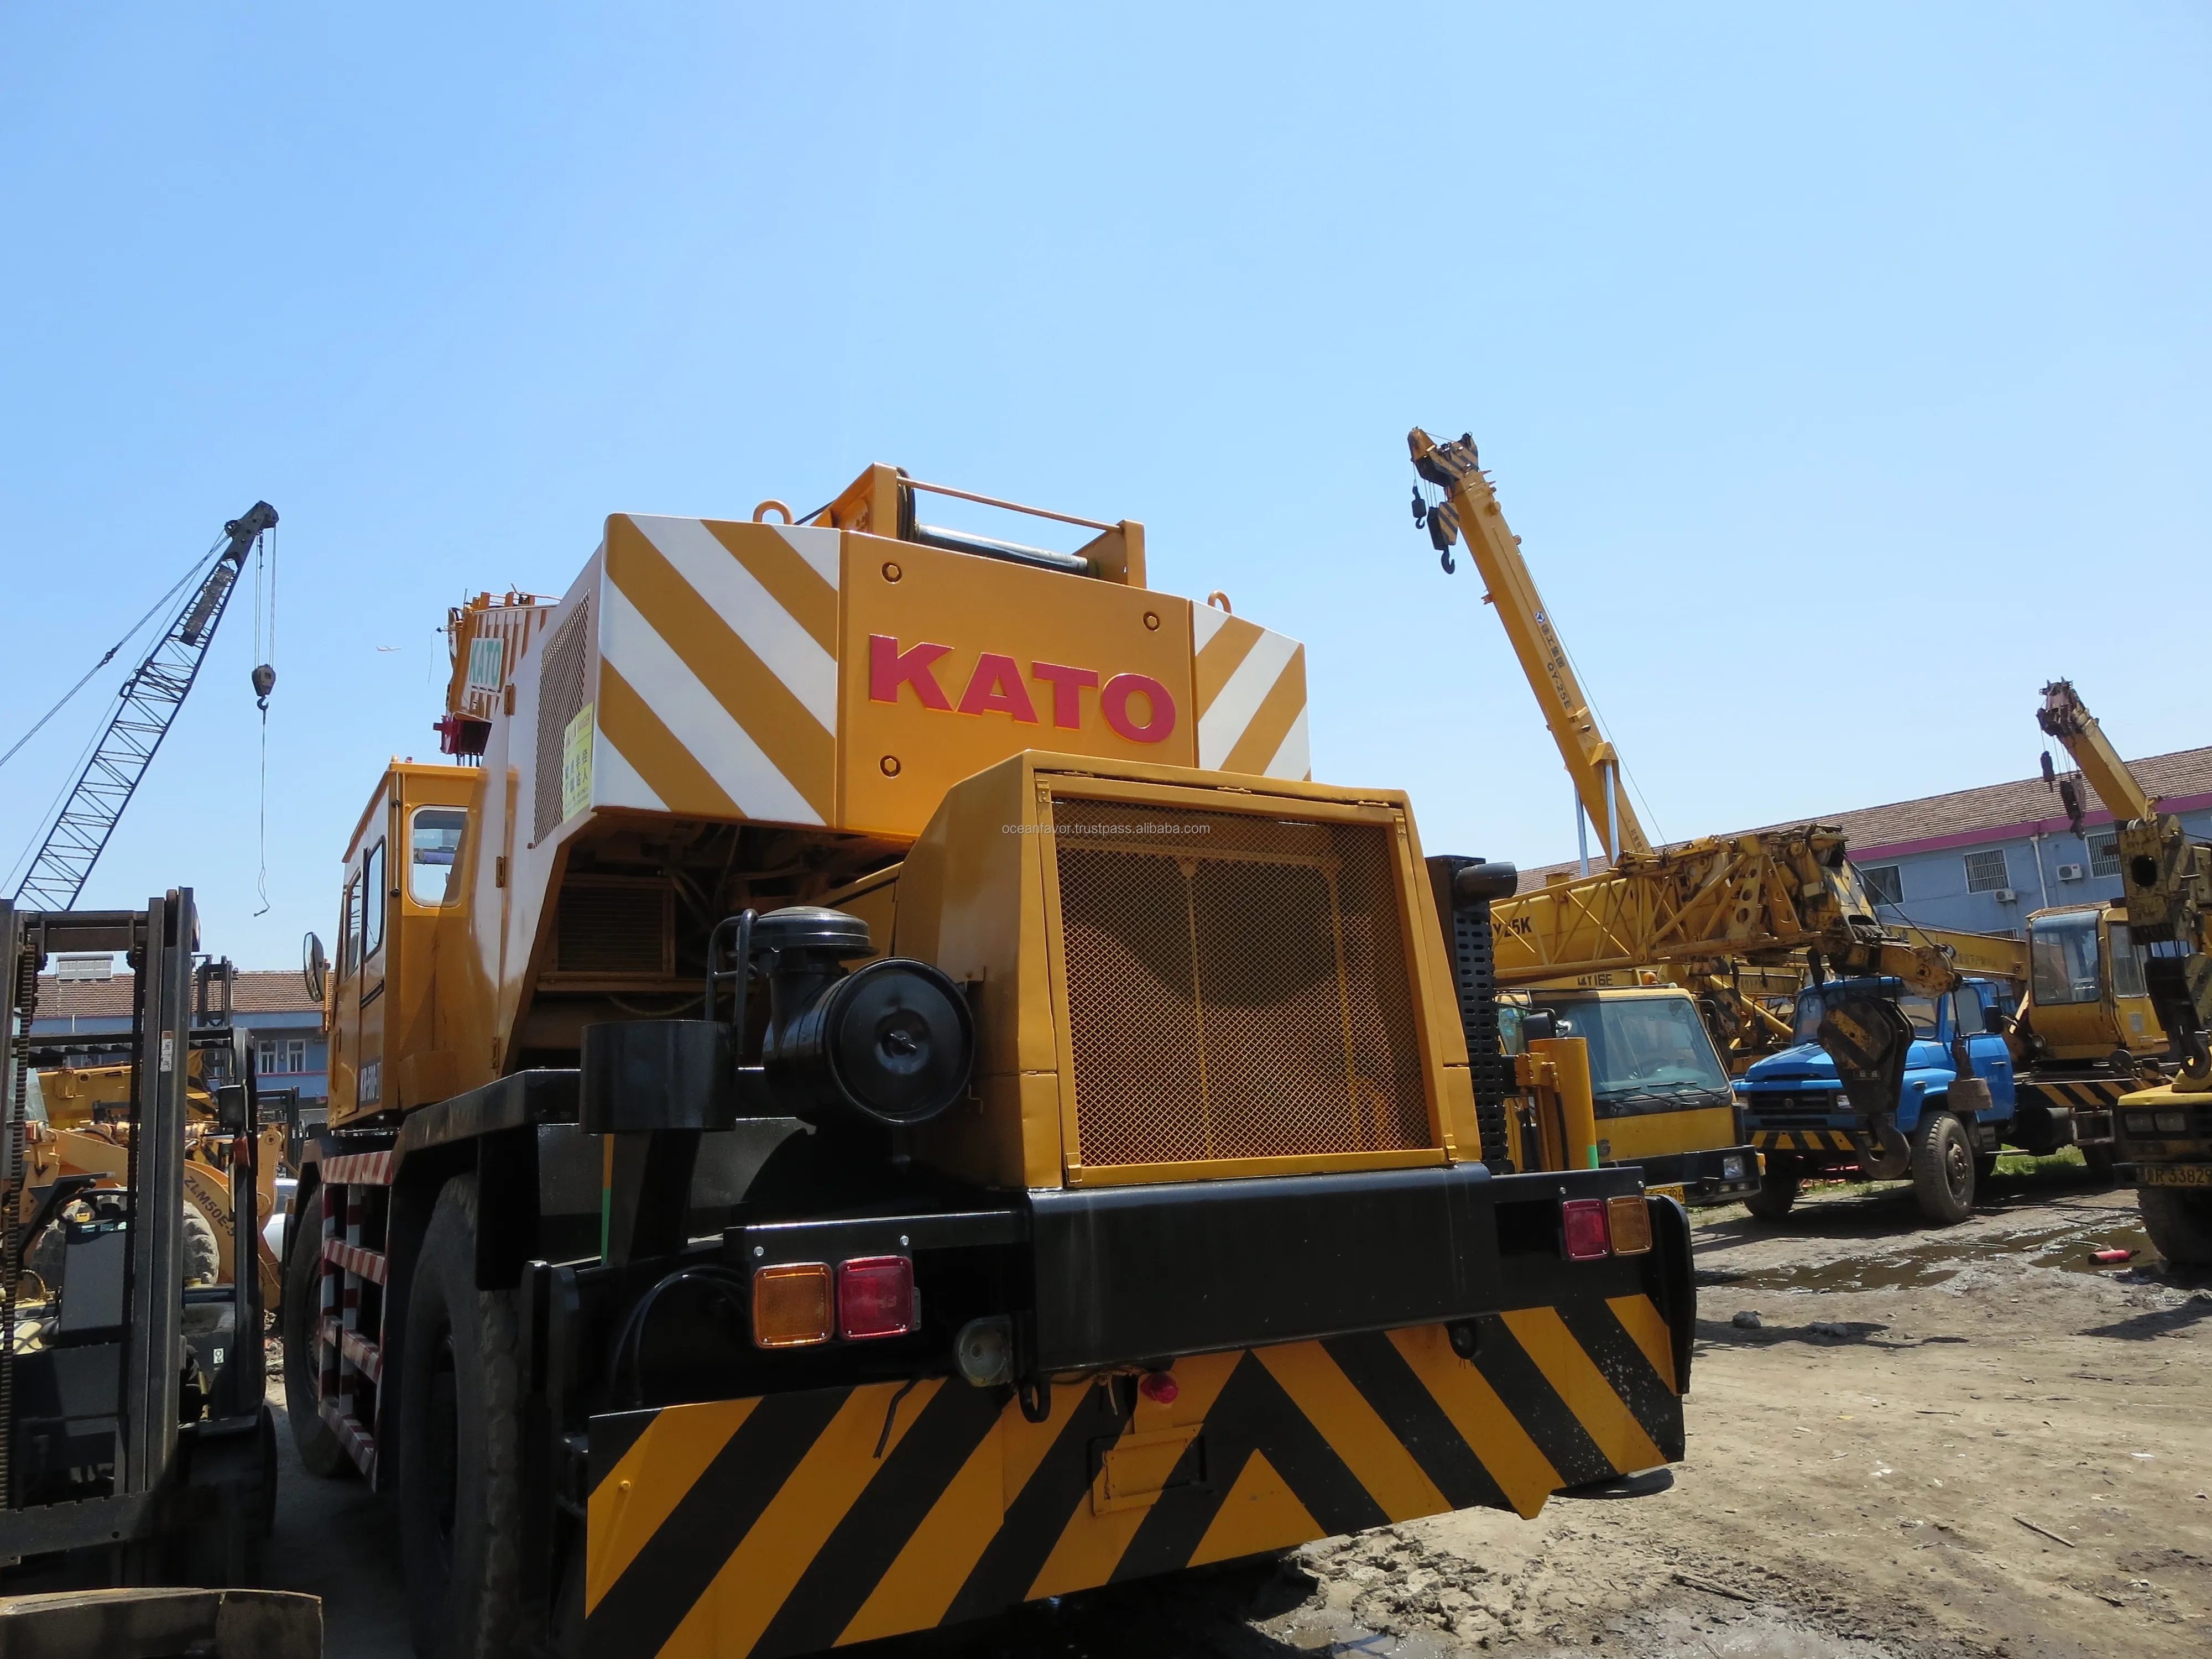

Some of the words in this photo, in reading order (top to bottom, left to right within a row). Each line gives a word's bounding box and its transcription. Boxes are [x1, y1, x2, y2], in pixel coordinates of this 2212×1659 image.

[469, 640, 501, 687] KATO
[1547, 662, 1572, 709] QY-25E
[869, 633, 1176, 744] KATO
